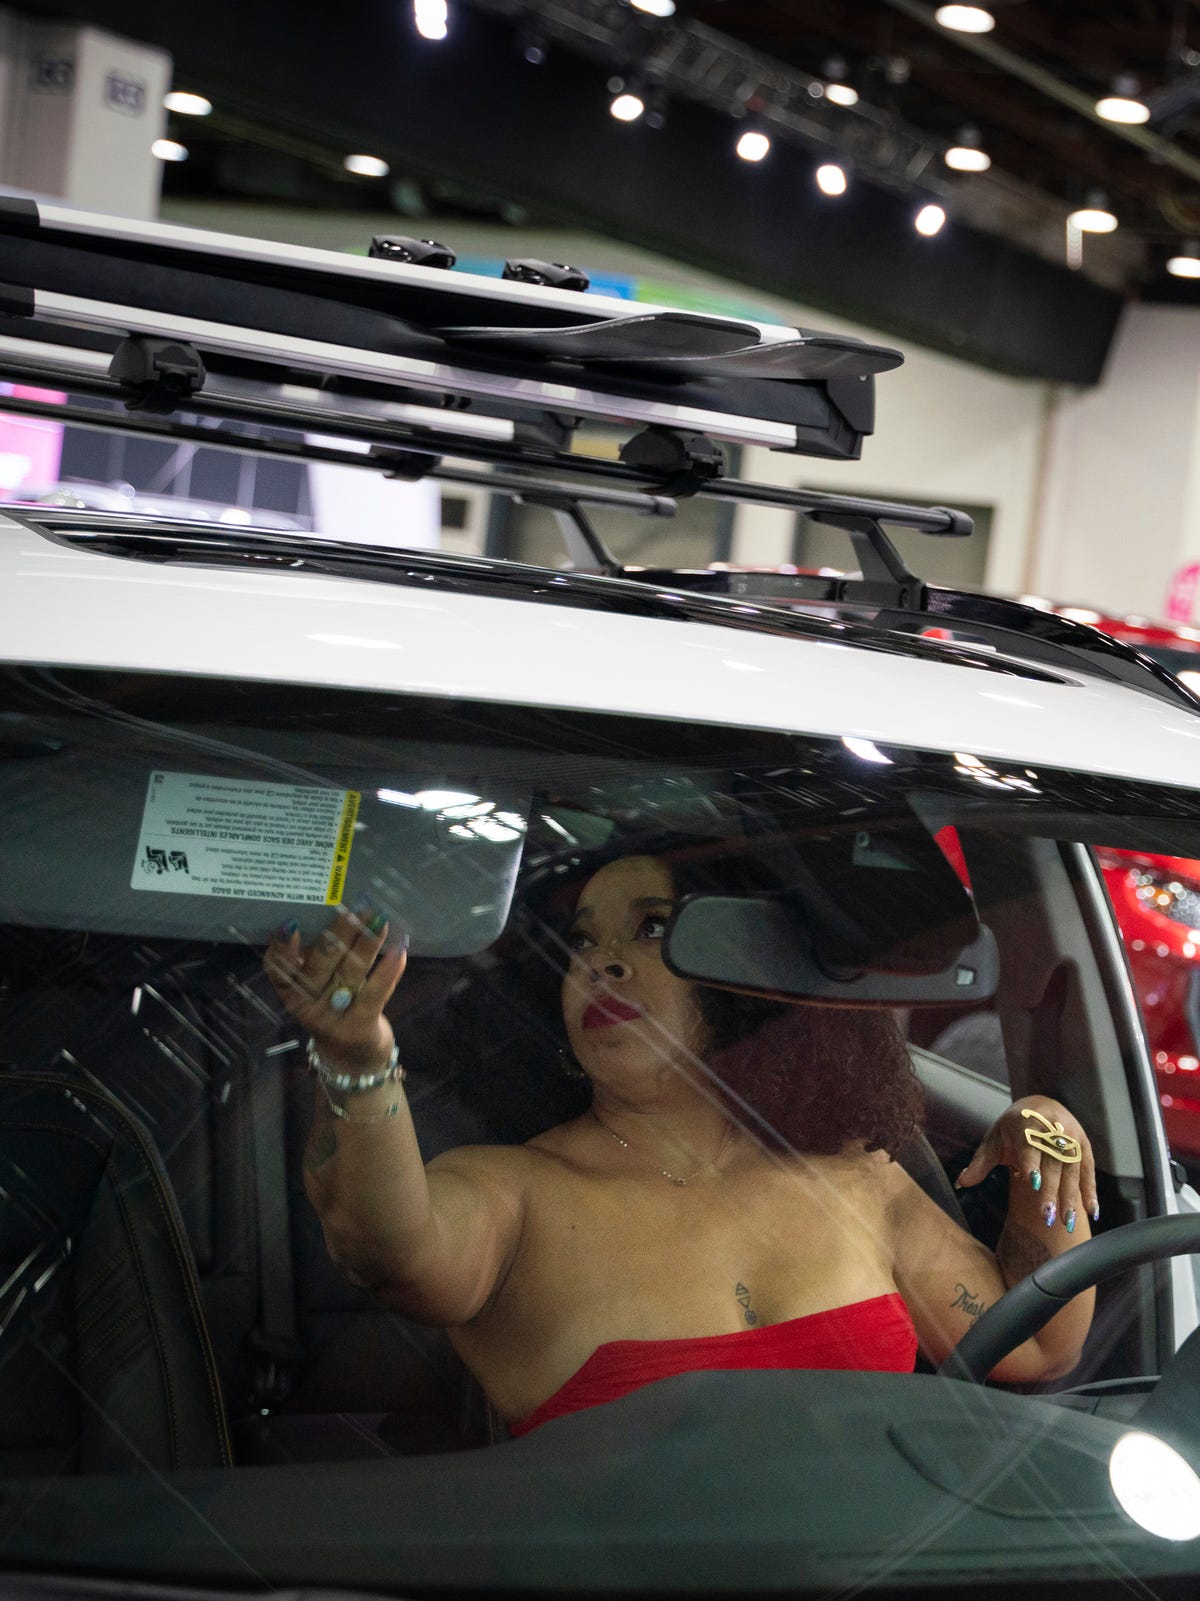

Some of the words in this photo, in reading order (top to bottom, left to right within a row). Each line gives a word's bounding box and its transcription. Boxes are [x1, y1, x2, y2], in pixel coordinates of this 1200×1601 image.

[339, 793, 356, 854] AVERTISSEMENT
[171, 827, 217, 837] INTELLIGENTS
[219, 831, 261, 841] GONFLABLES
[315, 841, 334, 849] MÊME
[329, 865, 343, 901] WARNING
[211, 886, 231, 894] BAGS
[247, 889, 285, 899] ADVANCED
[306, 894, 324, 902] EVEN
